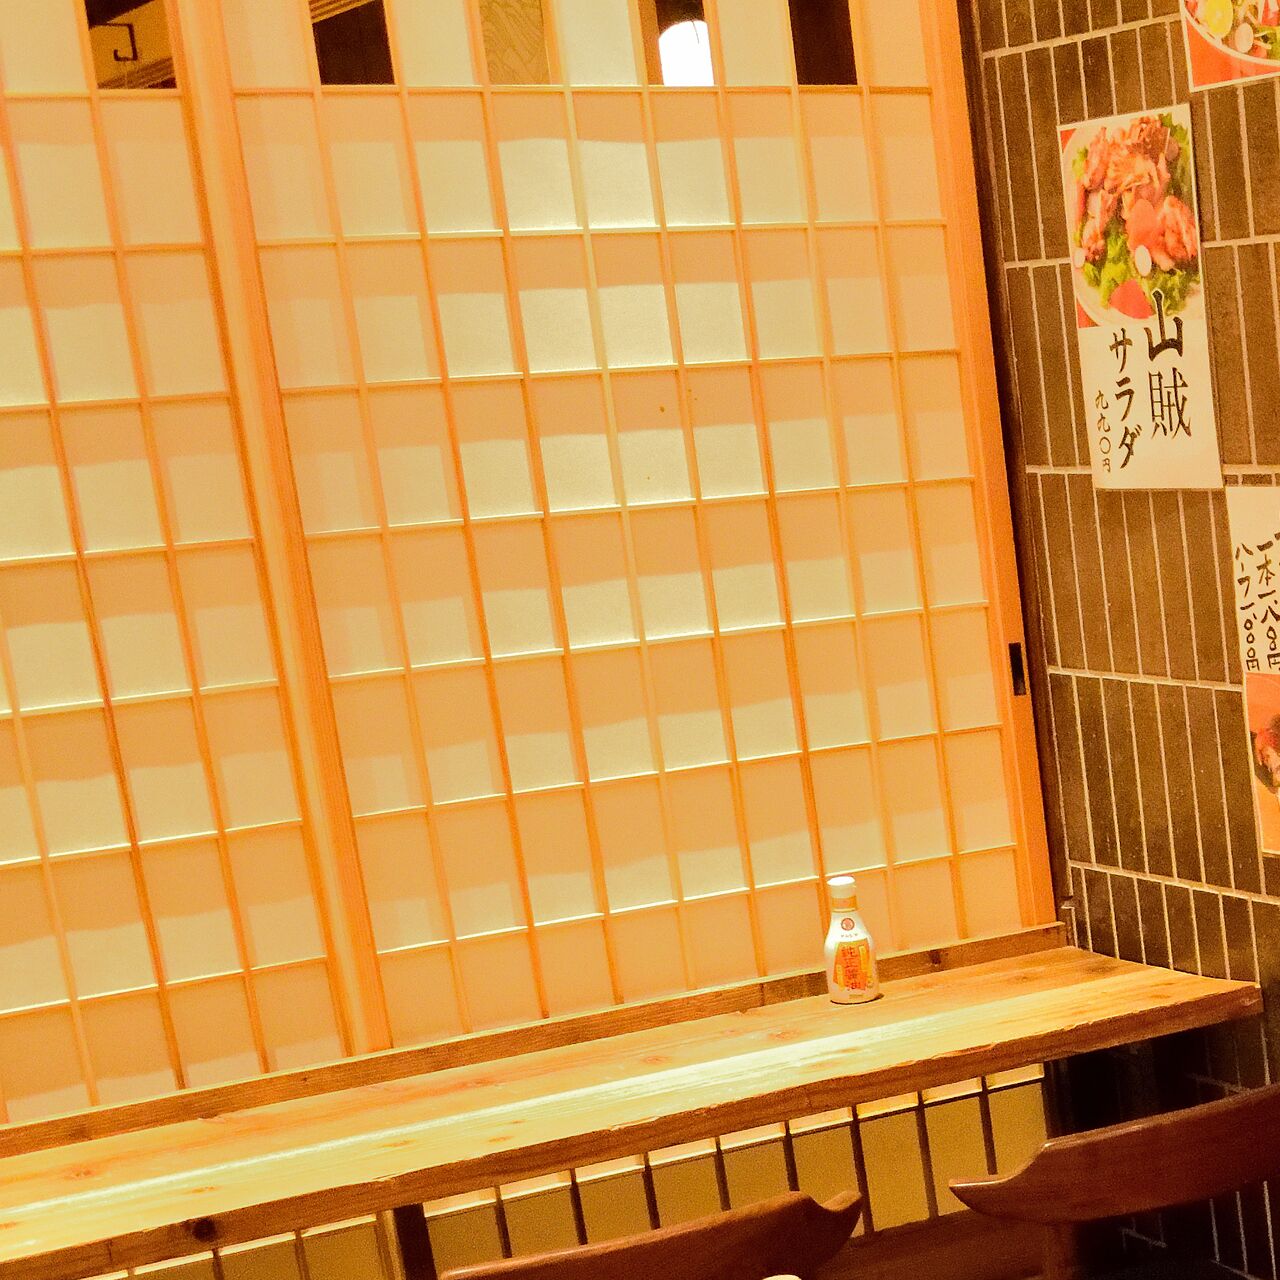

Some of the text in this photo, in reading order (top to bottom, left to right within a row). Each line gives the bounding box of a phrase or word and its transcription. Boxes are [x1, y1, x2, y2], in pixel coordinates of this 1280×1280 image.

[1109, 327, 1142, 469] サラダ
[1143, 289, 1193, 440] 山賊
